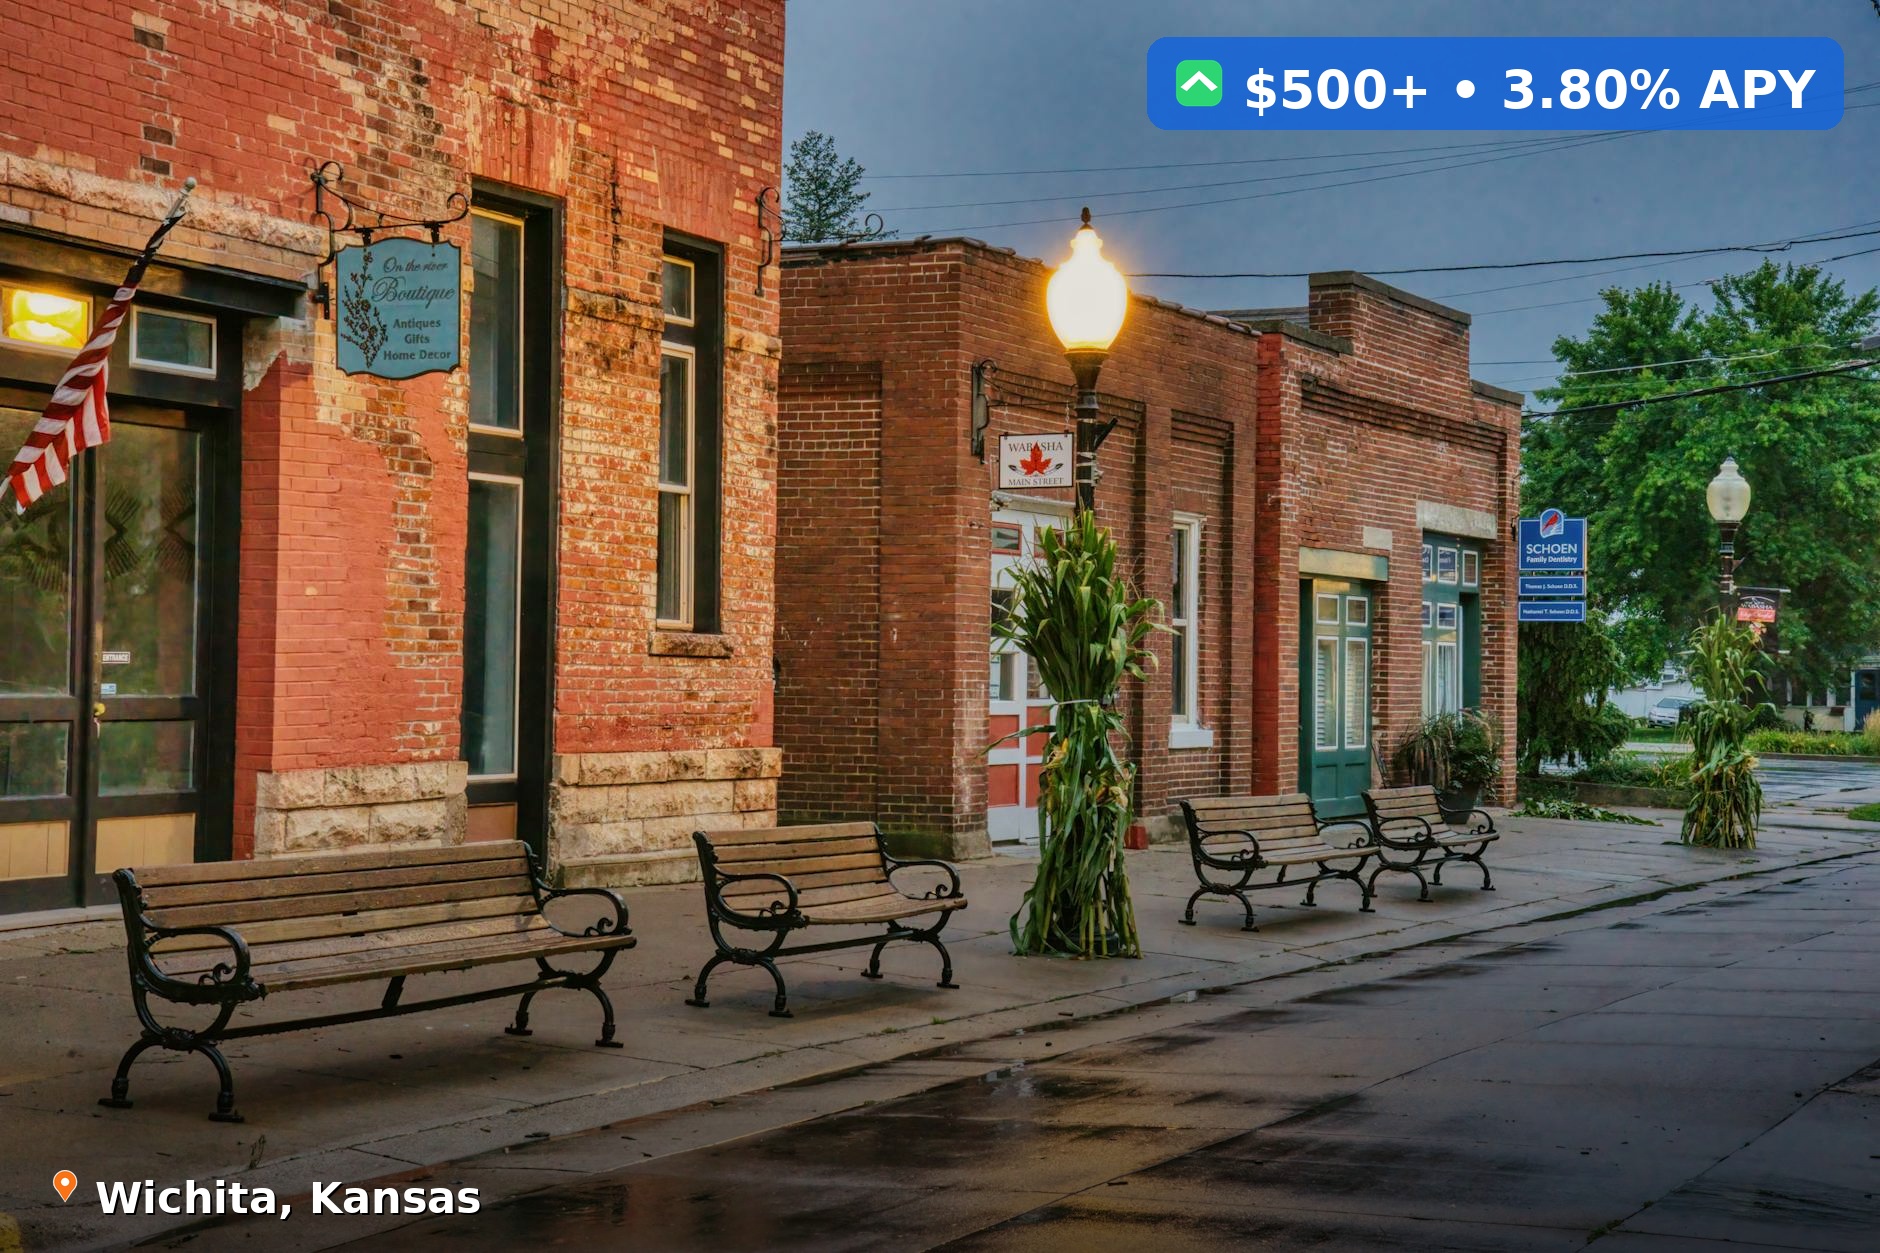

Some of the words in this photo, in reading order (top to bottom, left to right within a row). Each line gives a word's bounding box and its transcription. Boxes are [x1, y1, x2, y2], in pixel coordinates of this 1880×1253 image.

[383, 256, 403, 273] On
[405, 258, 421, 272] the
[422, 261, 449, 272] river
[371, 276, 455, 309] Boutique
[393, 317, 441, 331] Antiques
[404, 333, 430, 345] Gifts
[383, 350, 416, 361] Home
[419, 349, 451, 360] Decor
[1008, 441, 1063, 452] WABASHA
[1008, 478, 1031, 486] MAIN
[1032, 477, 1064, 486] STREET
[1526, 543, 1578, 554] SCHOEN
[1526, 556, 1547, 564] Family
[1548, 556, 1578, 564] Dentistry
